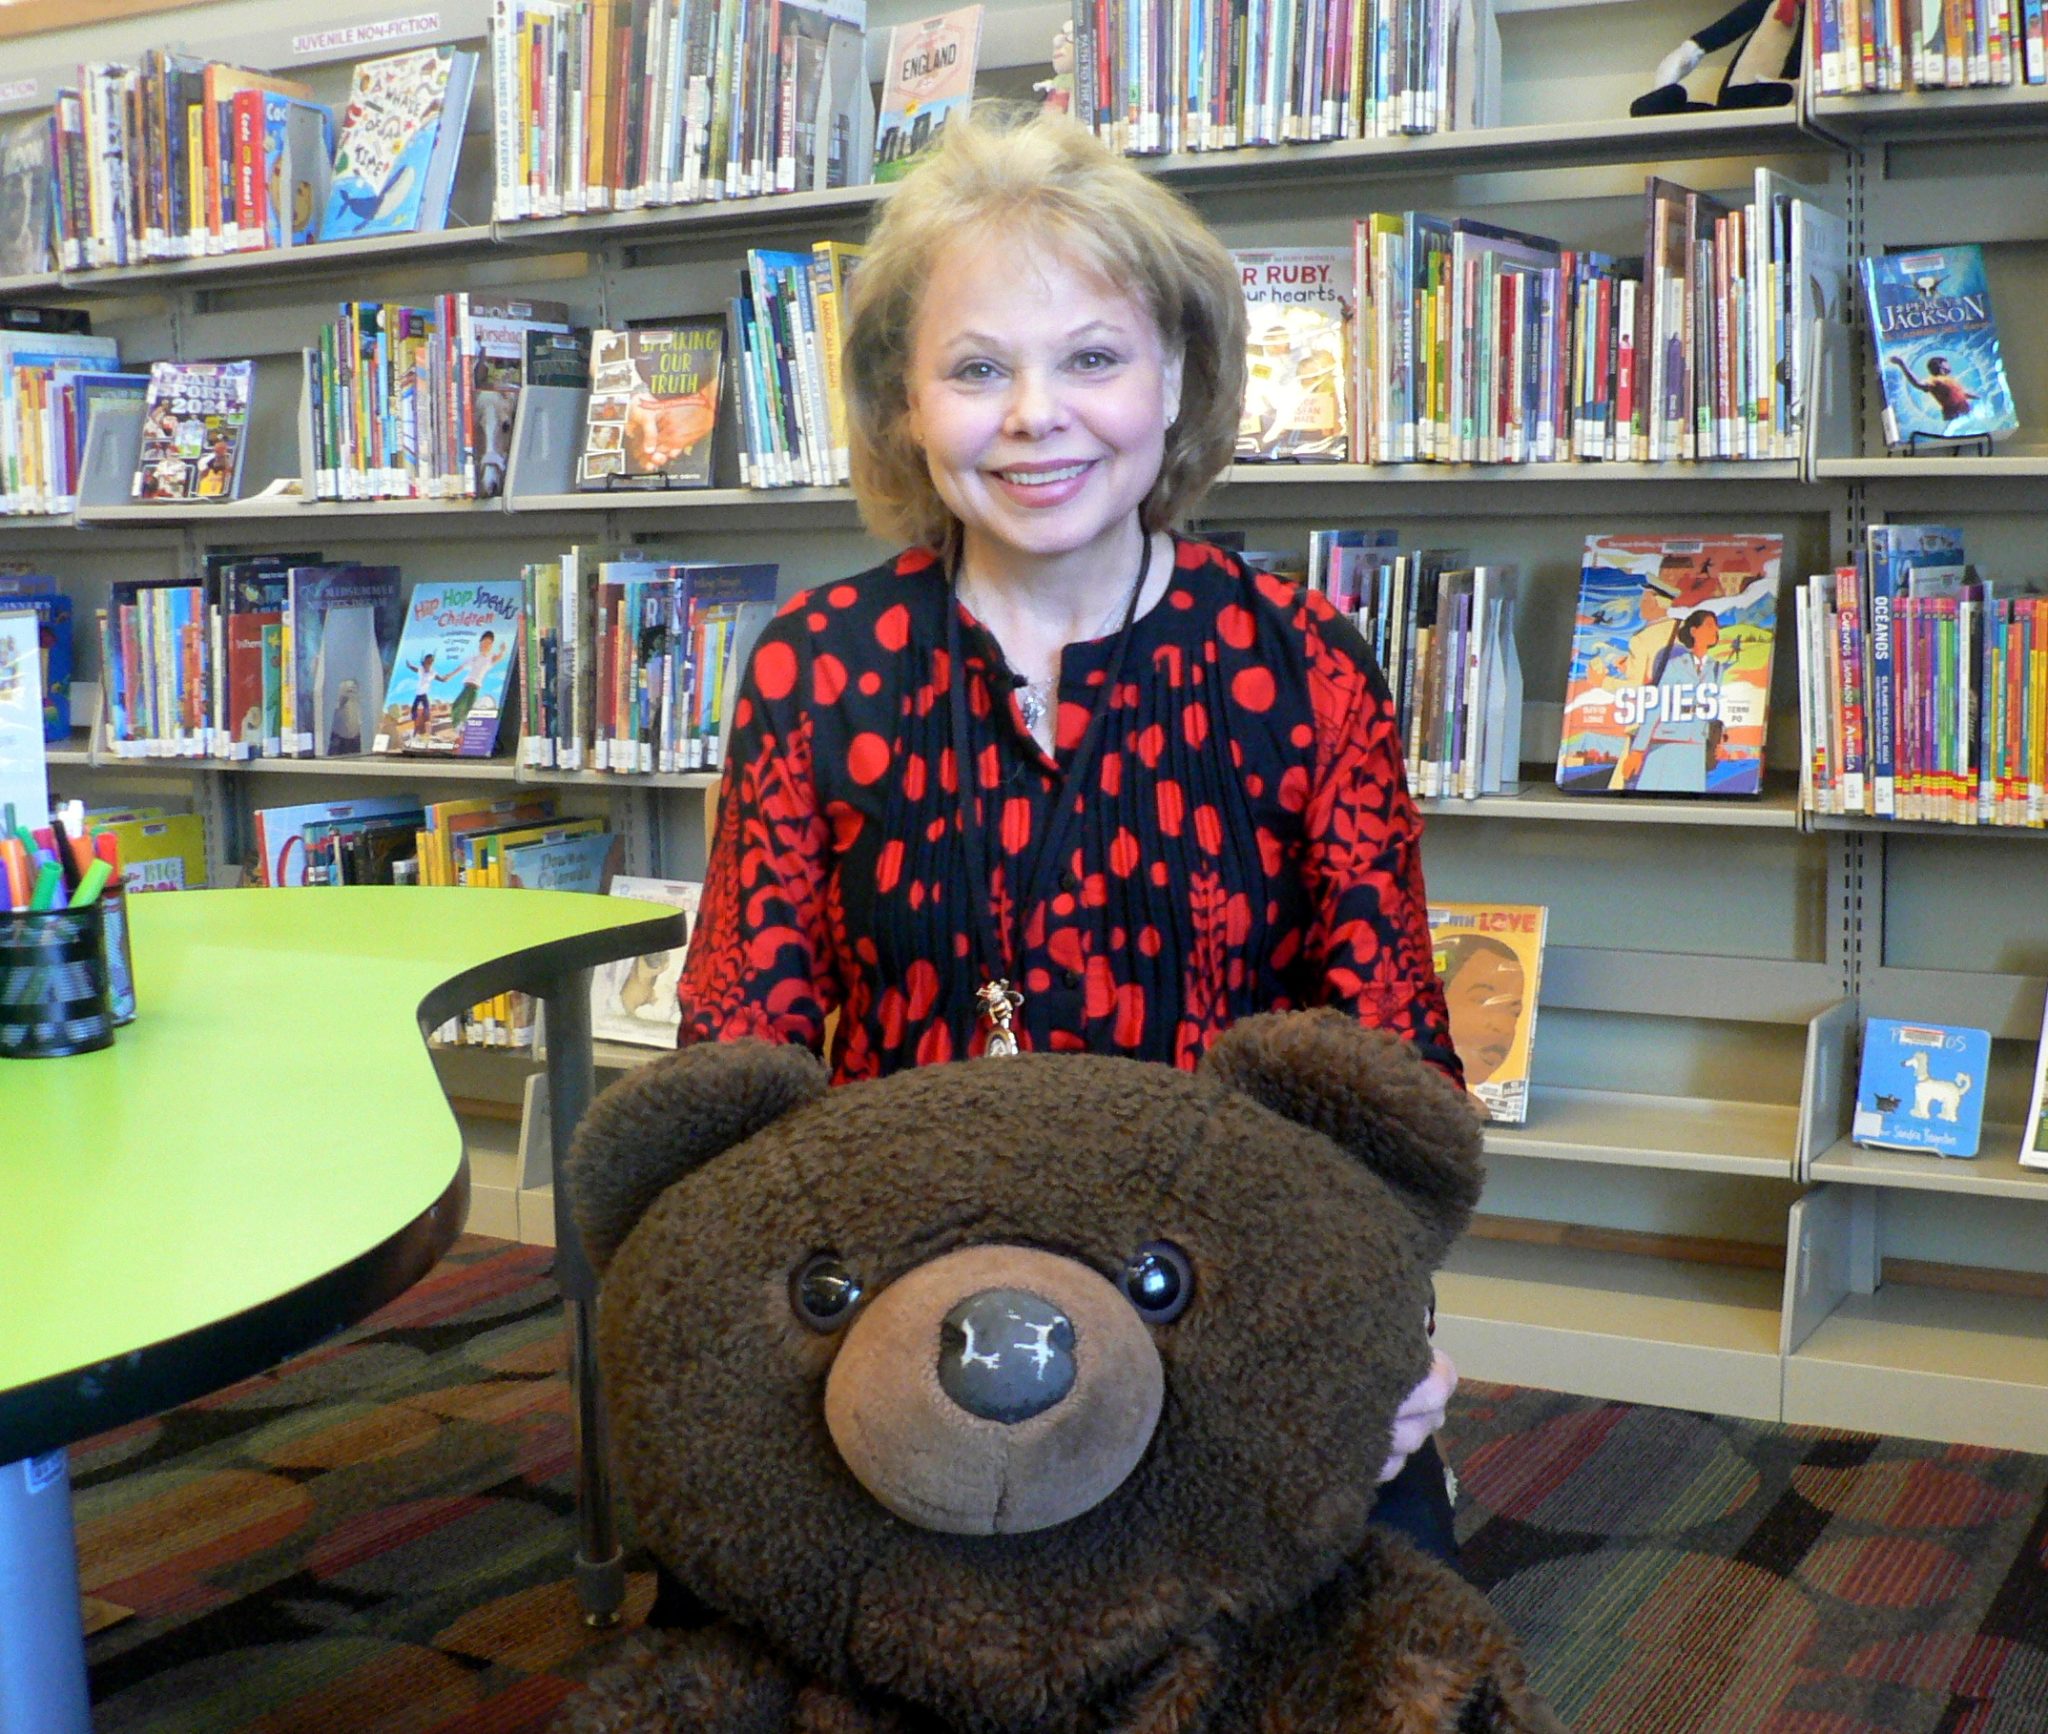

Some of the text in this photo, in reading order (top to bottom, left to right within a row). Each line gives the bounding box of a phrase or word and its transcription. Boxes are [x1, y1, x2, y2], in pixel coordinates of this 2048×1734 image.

[294, 16, 438, 51] JUVENILE NON-FICTION
[902, 44, 957, 82] ENGLAND
[1881, 294, 1985, 332] JACKSON
[660, 353, 692, 373] OUR
[651, 374, 698, 394] TRUTH
[171, 398, 229, 414] 2024
[1874, 596, 1891, 660] OCÉANOS
[1614, 683, 1718, 724] SPIES
[1479, 912, 1536, 933] LOVE
